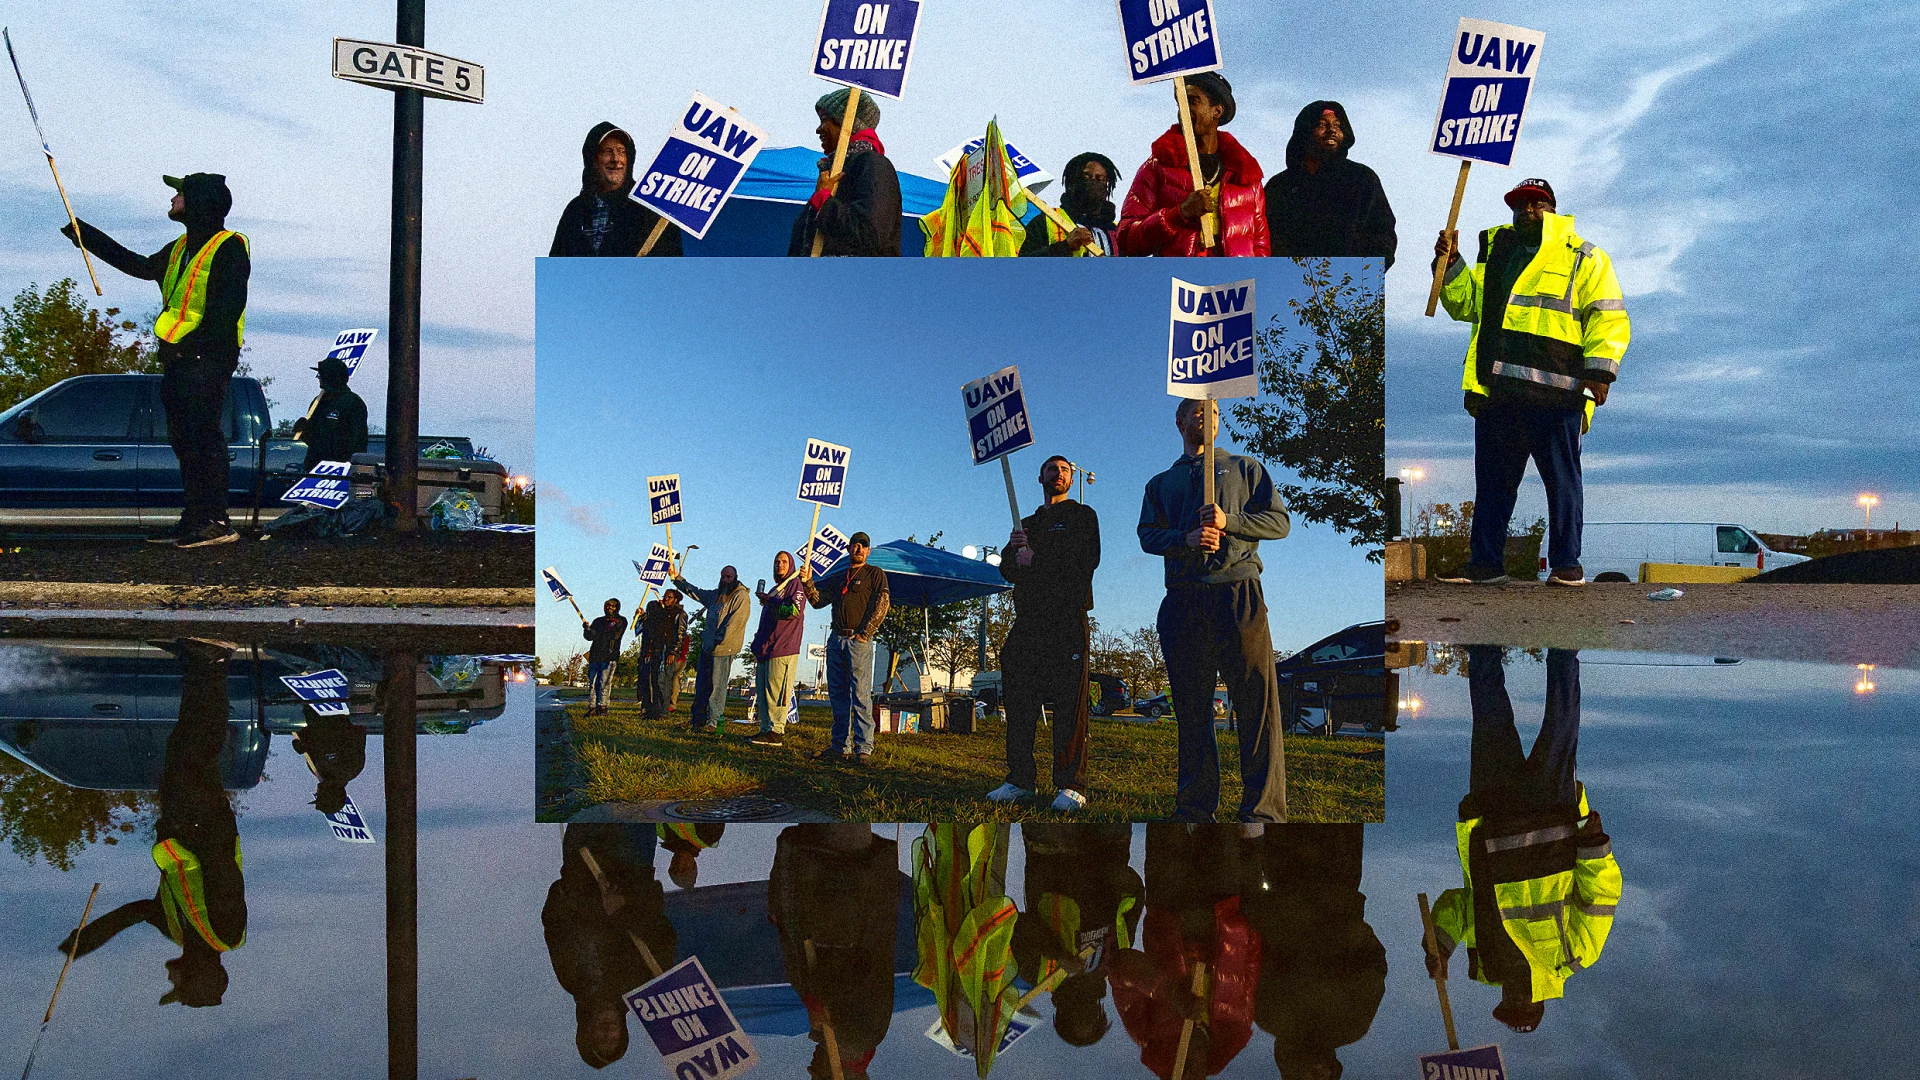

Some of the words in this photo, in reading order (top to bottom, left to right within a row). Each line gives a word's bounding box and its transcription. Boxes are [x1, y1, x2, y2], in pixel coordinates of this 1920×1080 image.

[853, 3, 890, 35] ON
[820, 38, 907, 71] STRIKE
[1131, 8, 1209, 74] STRIKE
[1457, 31, 1537, 75] UAW
[352, 47, 445, 87] GATE
[454, 66, 471, 91] 5
[1468, 83, 1503, 114] ON
[683, 101, 758, 159] UAW
[1438, 113, 1518, 148] STRIKE
[678, 152, 717, 181] ON
[640, 171, 723, 213] STRIKE
[1178, 286, 1249, 316] UAW
[335, 332, 373, 346] UAW
[1191, 322, 1224, 352] ON
[1172, 336, 1253, 380] STRIKE
[965, 372, 1015, 409] UAW
[986, 401, 1007, 429] ON
[976, 411, 1026, 458] STRIKE
[808, 443, 847, 465] UAW
[314, 464, 345, 475] UA
[815, 467, 832, 481] ON
[288, 488, 349, 501] STRIKE
[314, 479, 342, 490] ON
[649, 478, 678, 493] UAW
[801, 482, 842, 497] STRIKE
[653, 503, 681, 523] STRIKE
[659, 494, 671, 508] ON
[816, 543, 832, 556] ON
[821, 527, 849, 554] UAW
[652, 561, 663, 571] ON
[798, 546, 834, 569] SRIKE
[641, 570, 668, 580] STRIKE
